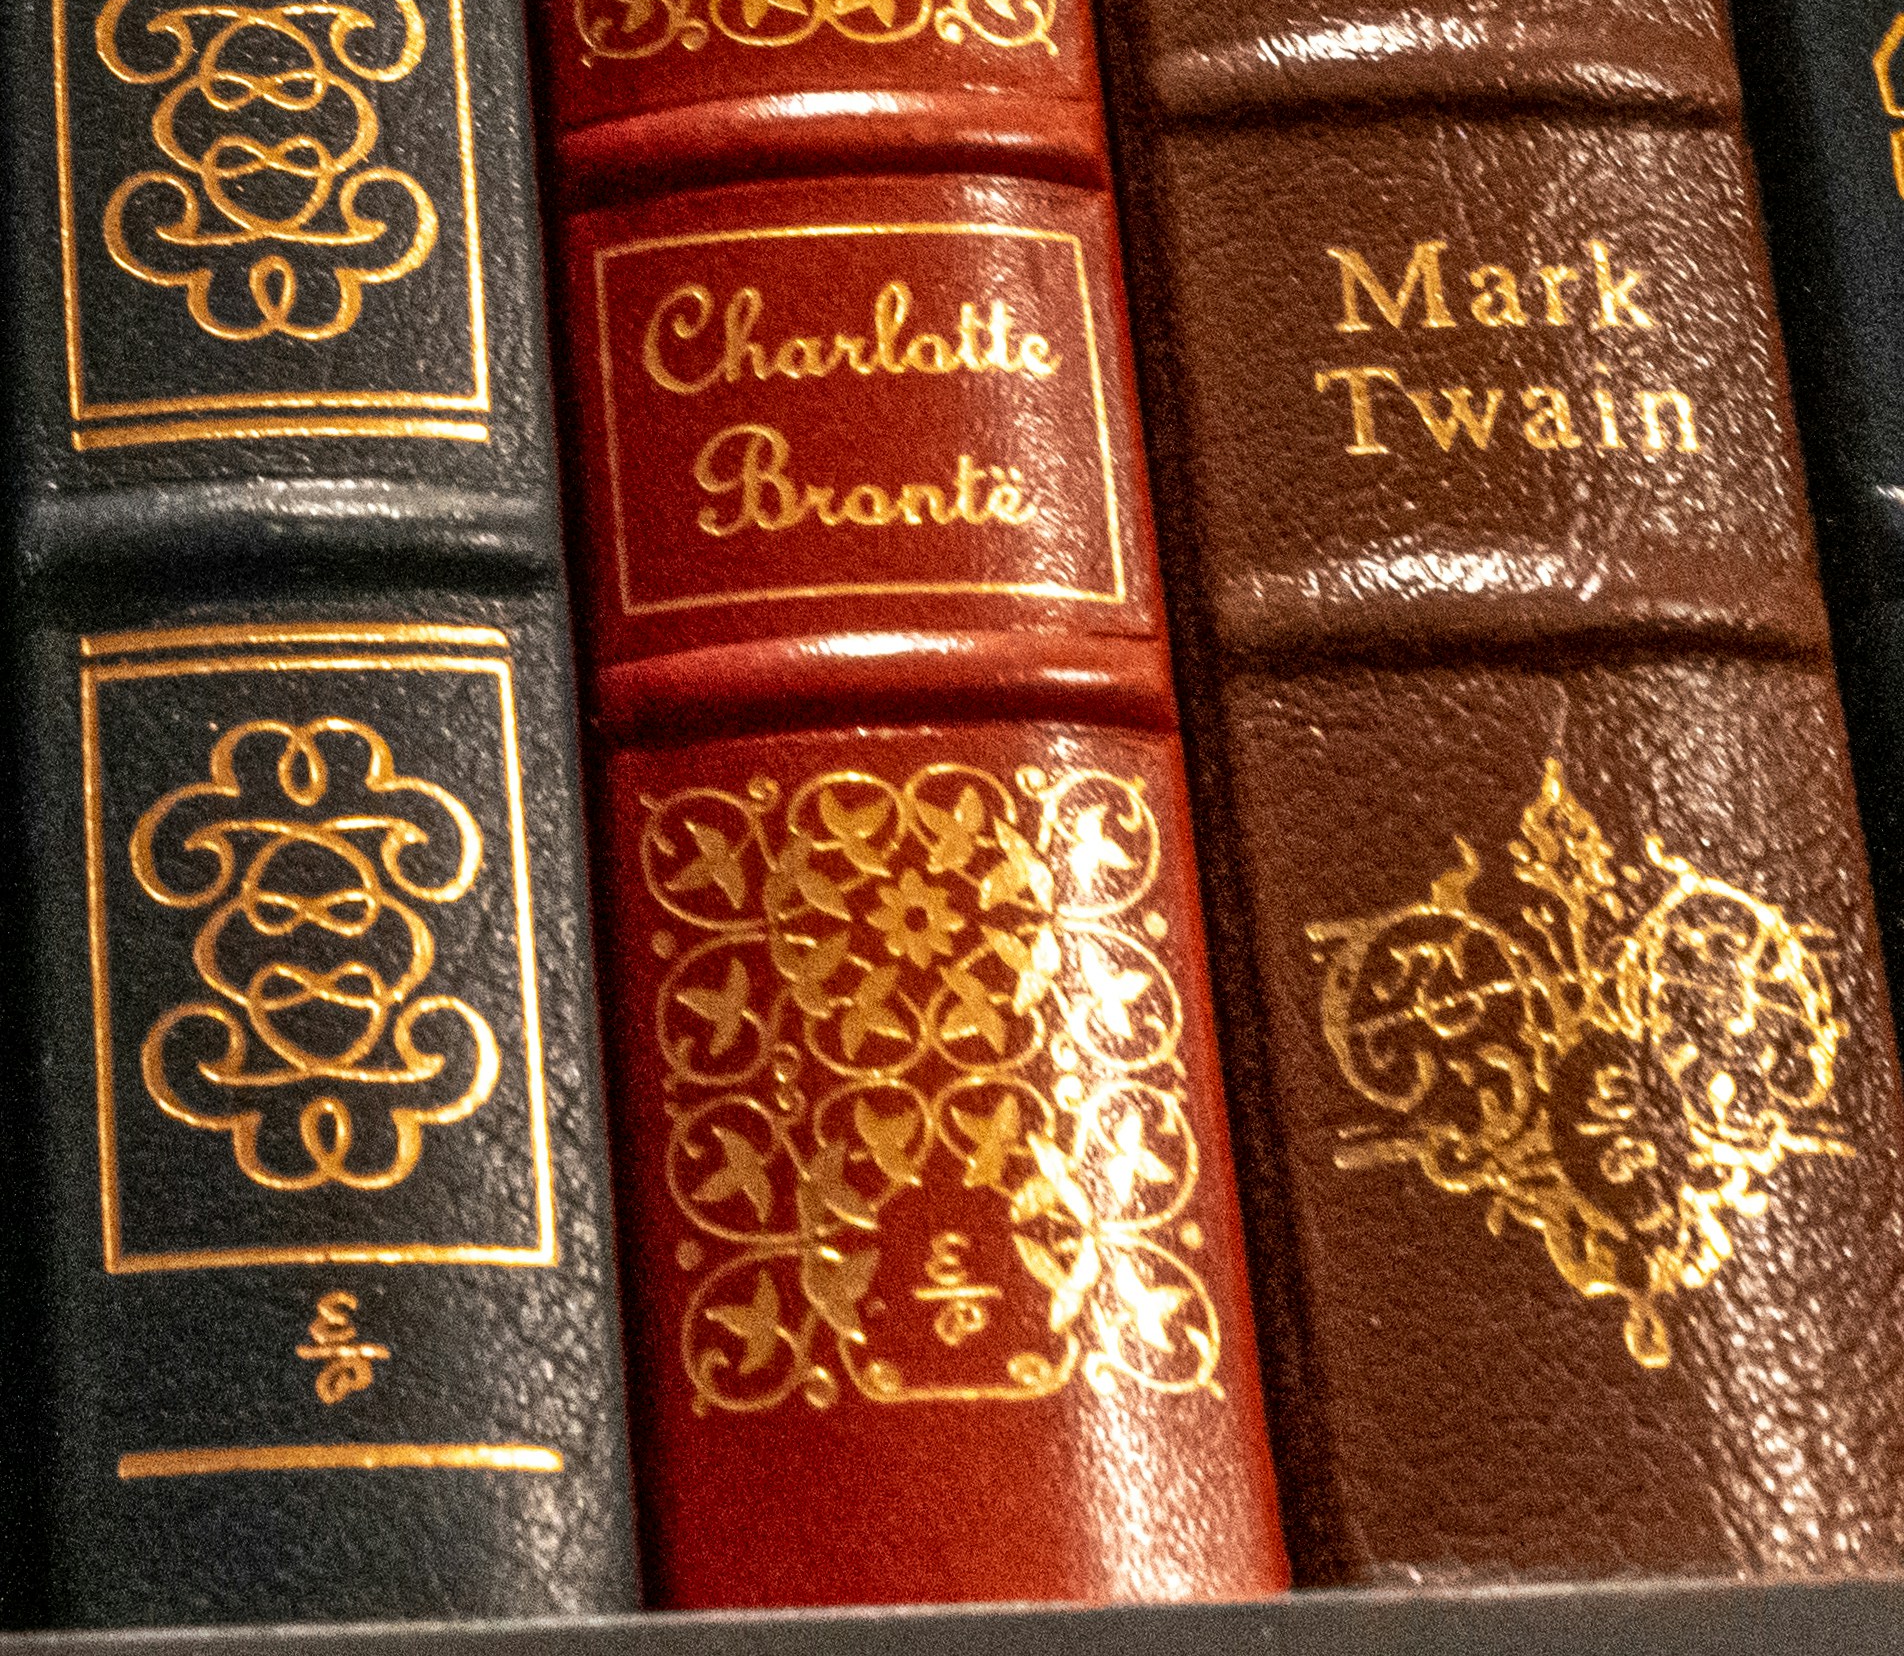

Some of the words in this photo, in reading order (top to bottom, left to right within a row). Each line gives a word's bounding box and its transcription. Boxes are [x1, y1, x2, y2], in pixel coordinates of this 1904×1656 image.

[642, 280, 1063, 396] Charlotte
[1325, 238, 1661, 333] Mark
[1314, 362, 1703, 457] Twain
[692, 423, 1039, 538] Brontë
